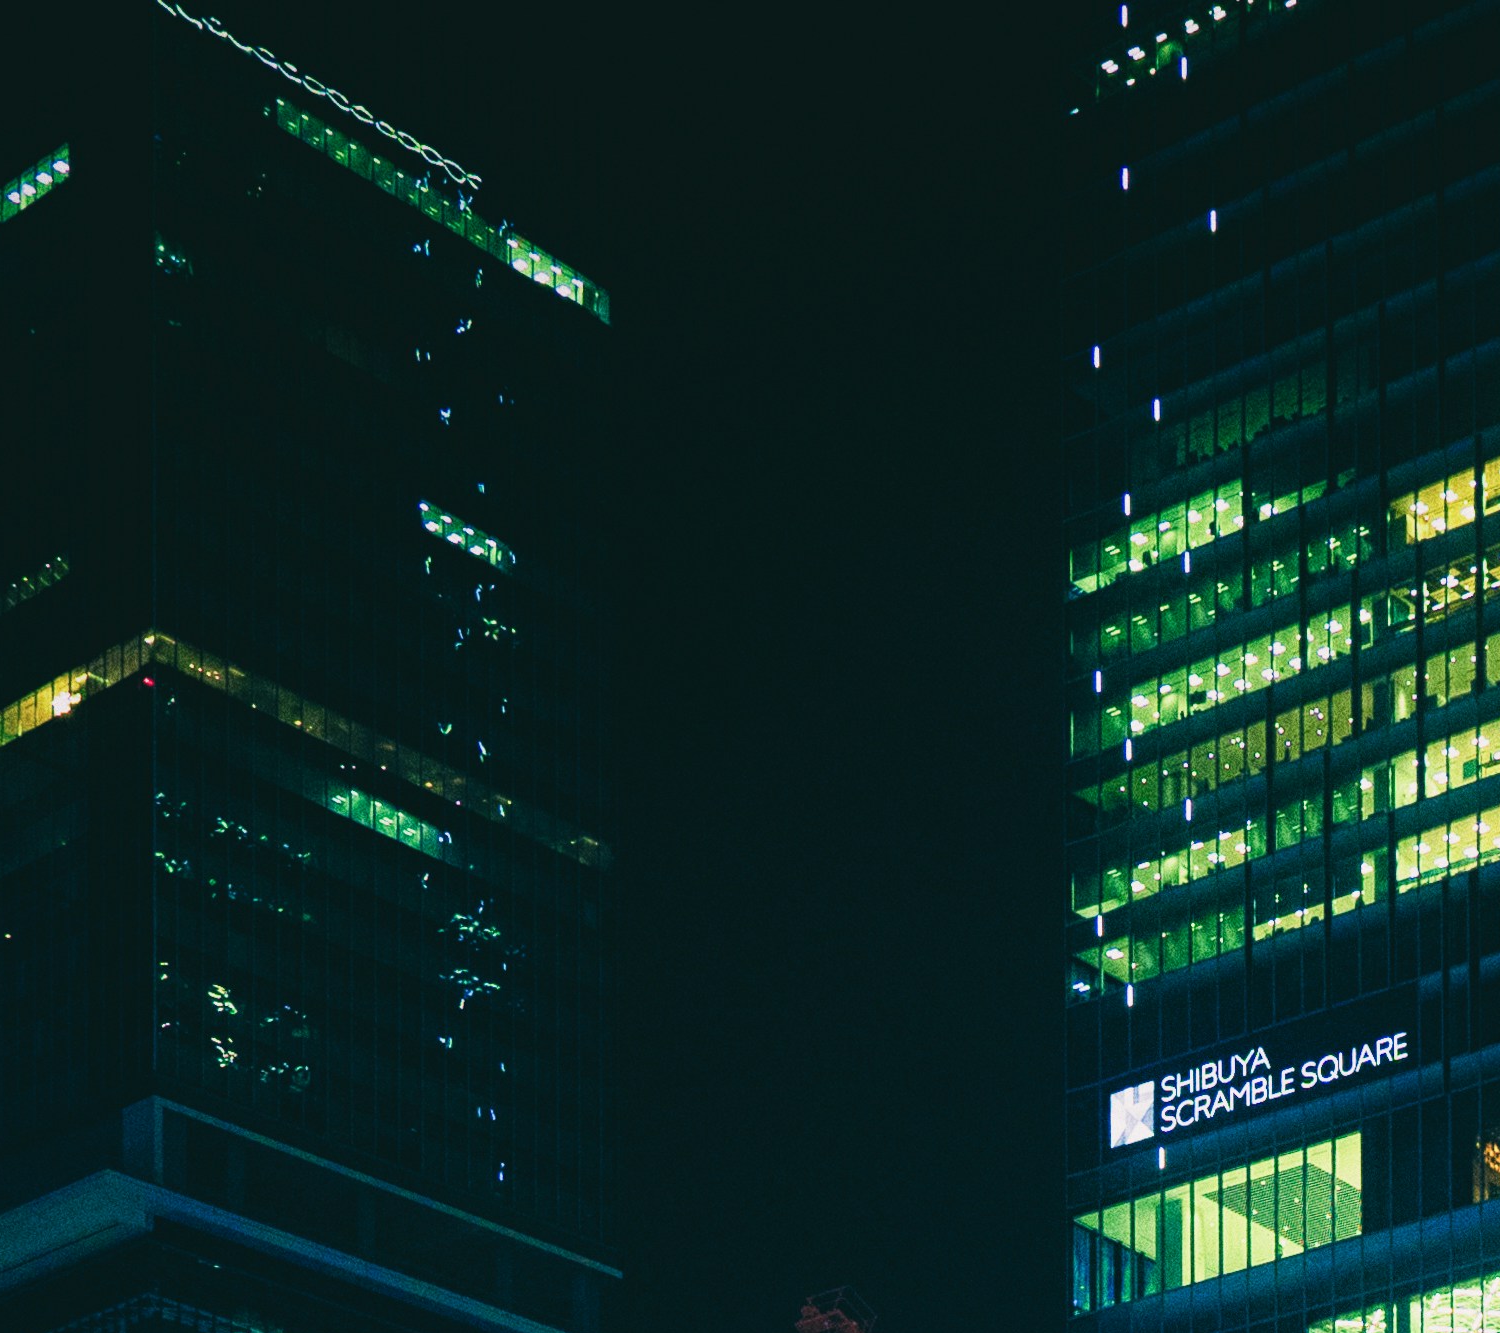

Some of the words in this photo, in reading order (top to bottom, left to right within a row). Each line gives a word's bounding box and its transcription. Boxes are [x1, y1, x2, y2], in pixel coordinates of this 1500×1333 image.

[1160, 1047, 1271, 1103] SHIBUYA
[1160, 1068, 1296, 1133] SCRAMBLE
[1300, 1032, 1409, 1089] SQUARE
